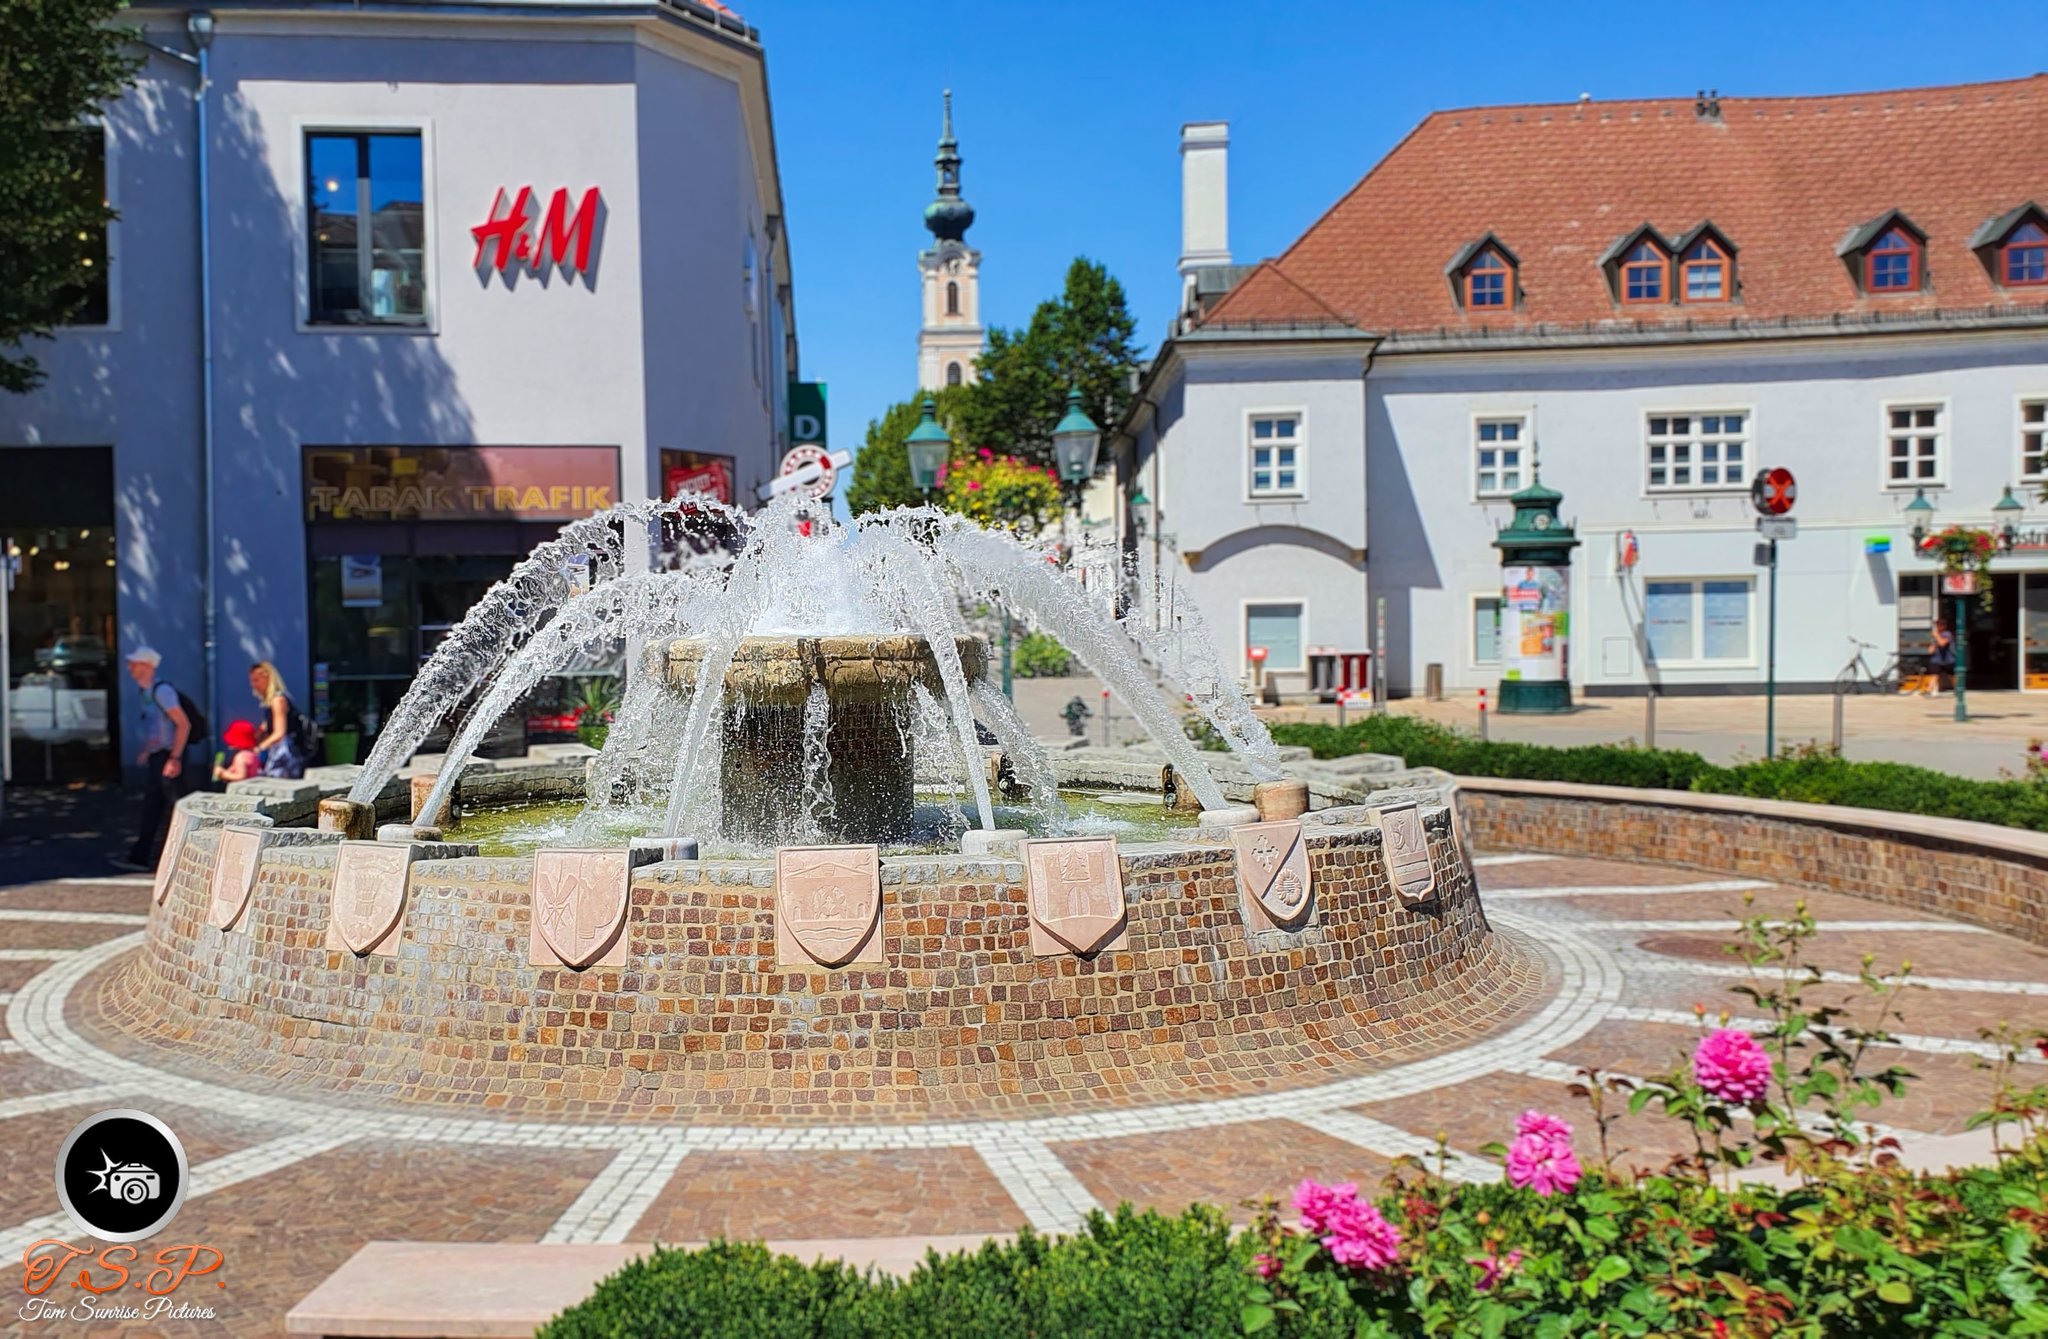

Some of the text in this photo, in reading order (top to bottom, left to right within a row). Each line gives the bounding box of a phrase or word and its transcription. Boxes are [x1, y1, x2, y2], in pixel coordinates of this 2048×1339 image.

[471, 185, 600, 273] H&M
[794, 415, 821, 440] D
[310, 485, 613, 513] TABAK TRAFIK
